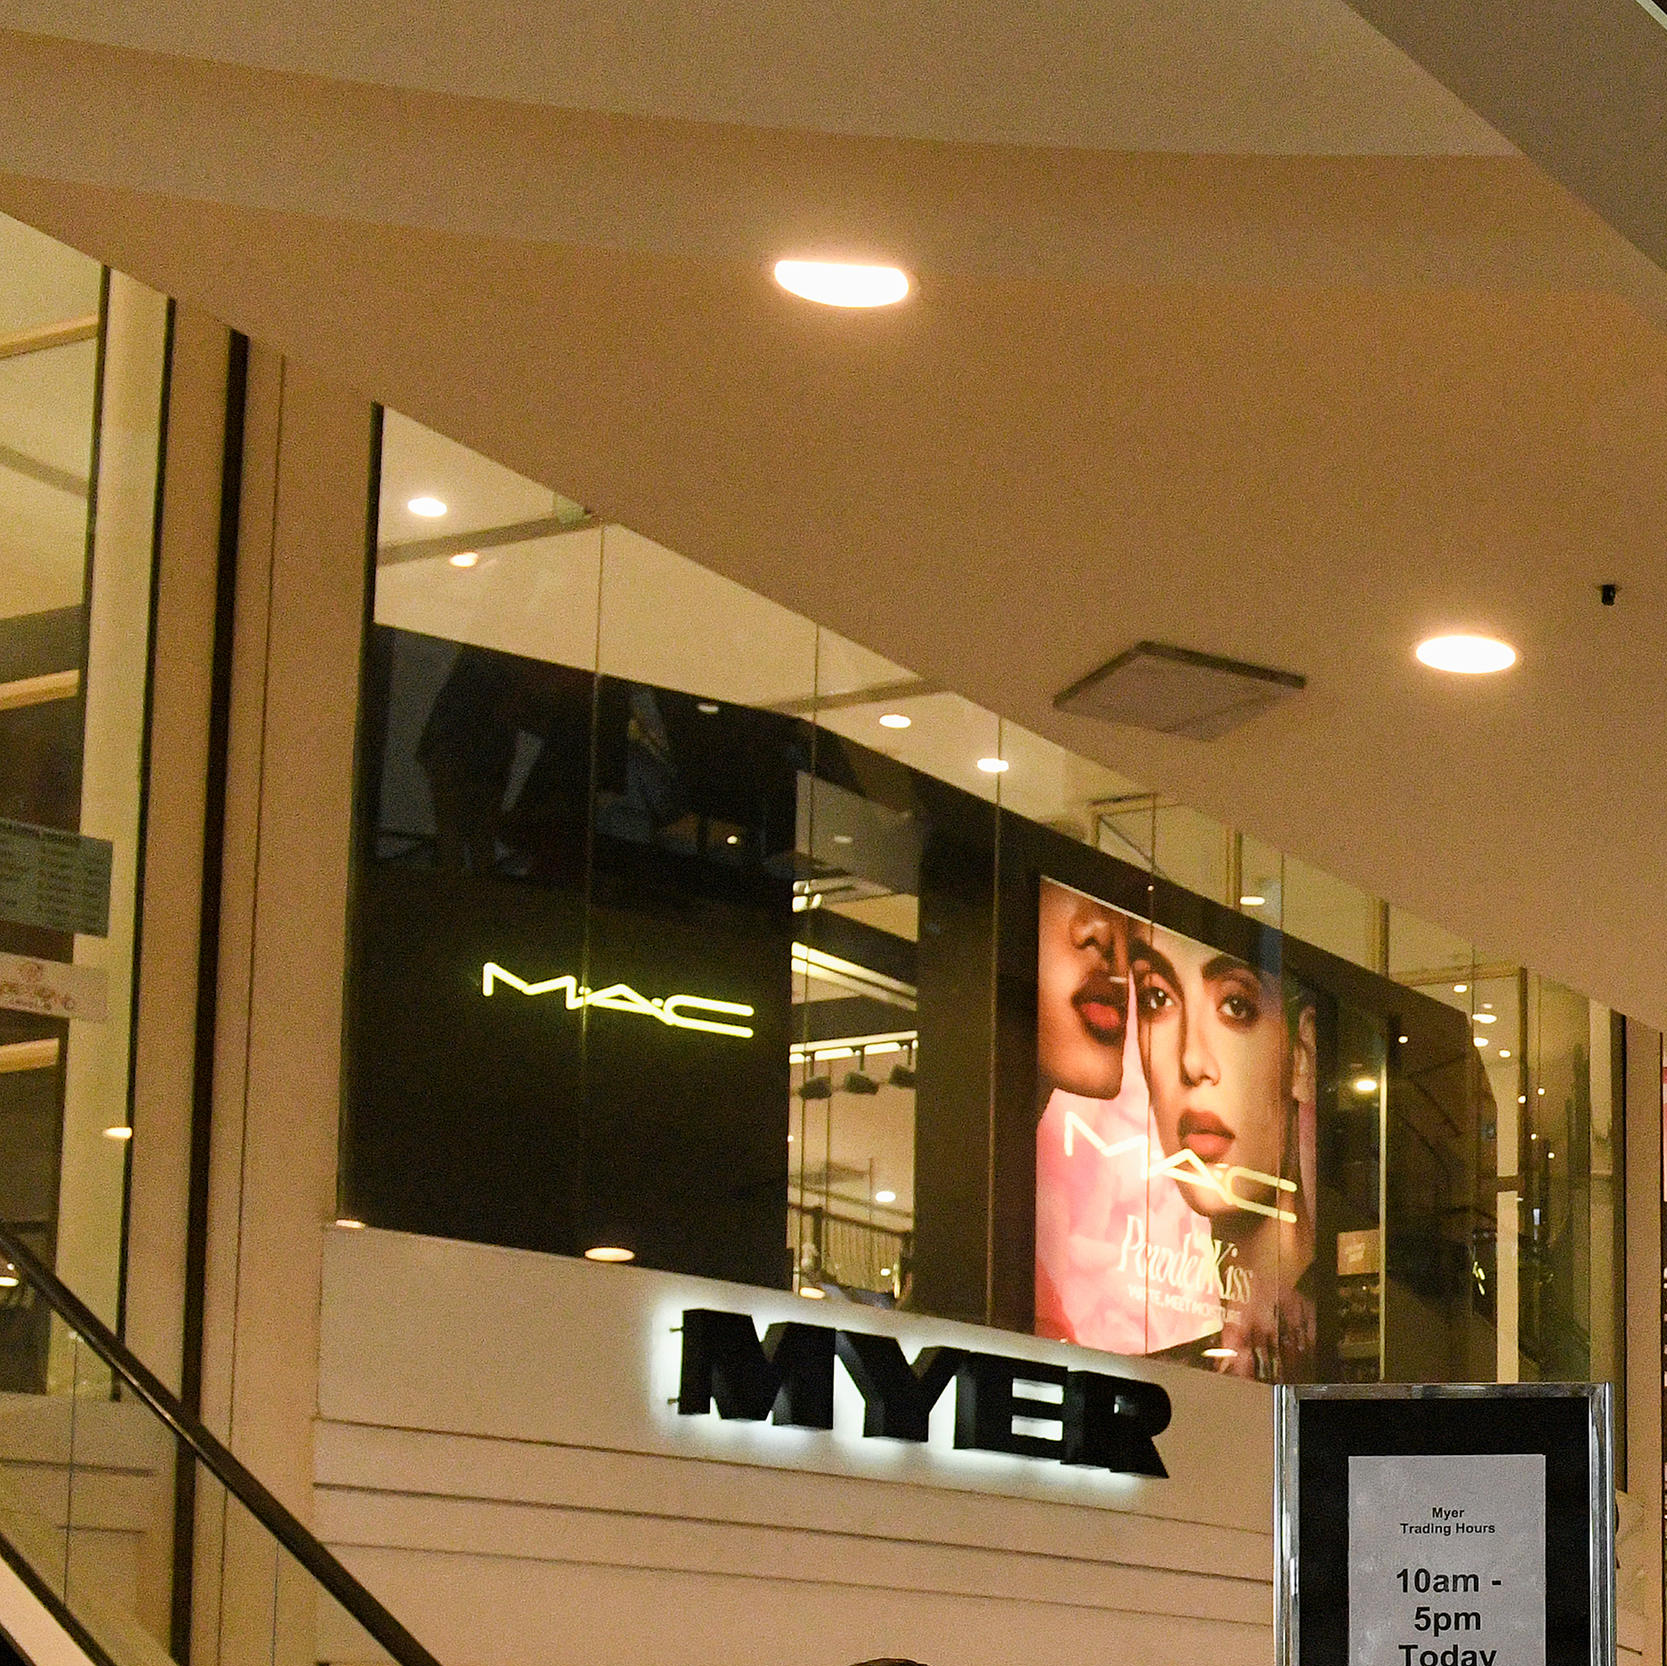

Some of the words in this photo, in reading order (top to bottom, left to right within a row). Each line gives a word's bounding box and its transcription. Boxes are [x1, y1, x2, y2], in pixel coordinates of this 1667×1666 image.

[678, 1308, 1171, 1478] MYER
[1432, 1507, 1465, 1520] Myer
[1401, 1522, 1452, 1536] Trading
[1456, 1522, 1496, 1534] Hours
[1396, 1568, 1480, 1593] 10am
[1414, 1606, 1482, 1636] 5pm
